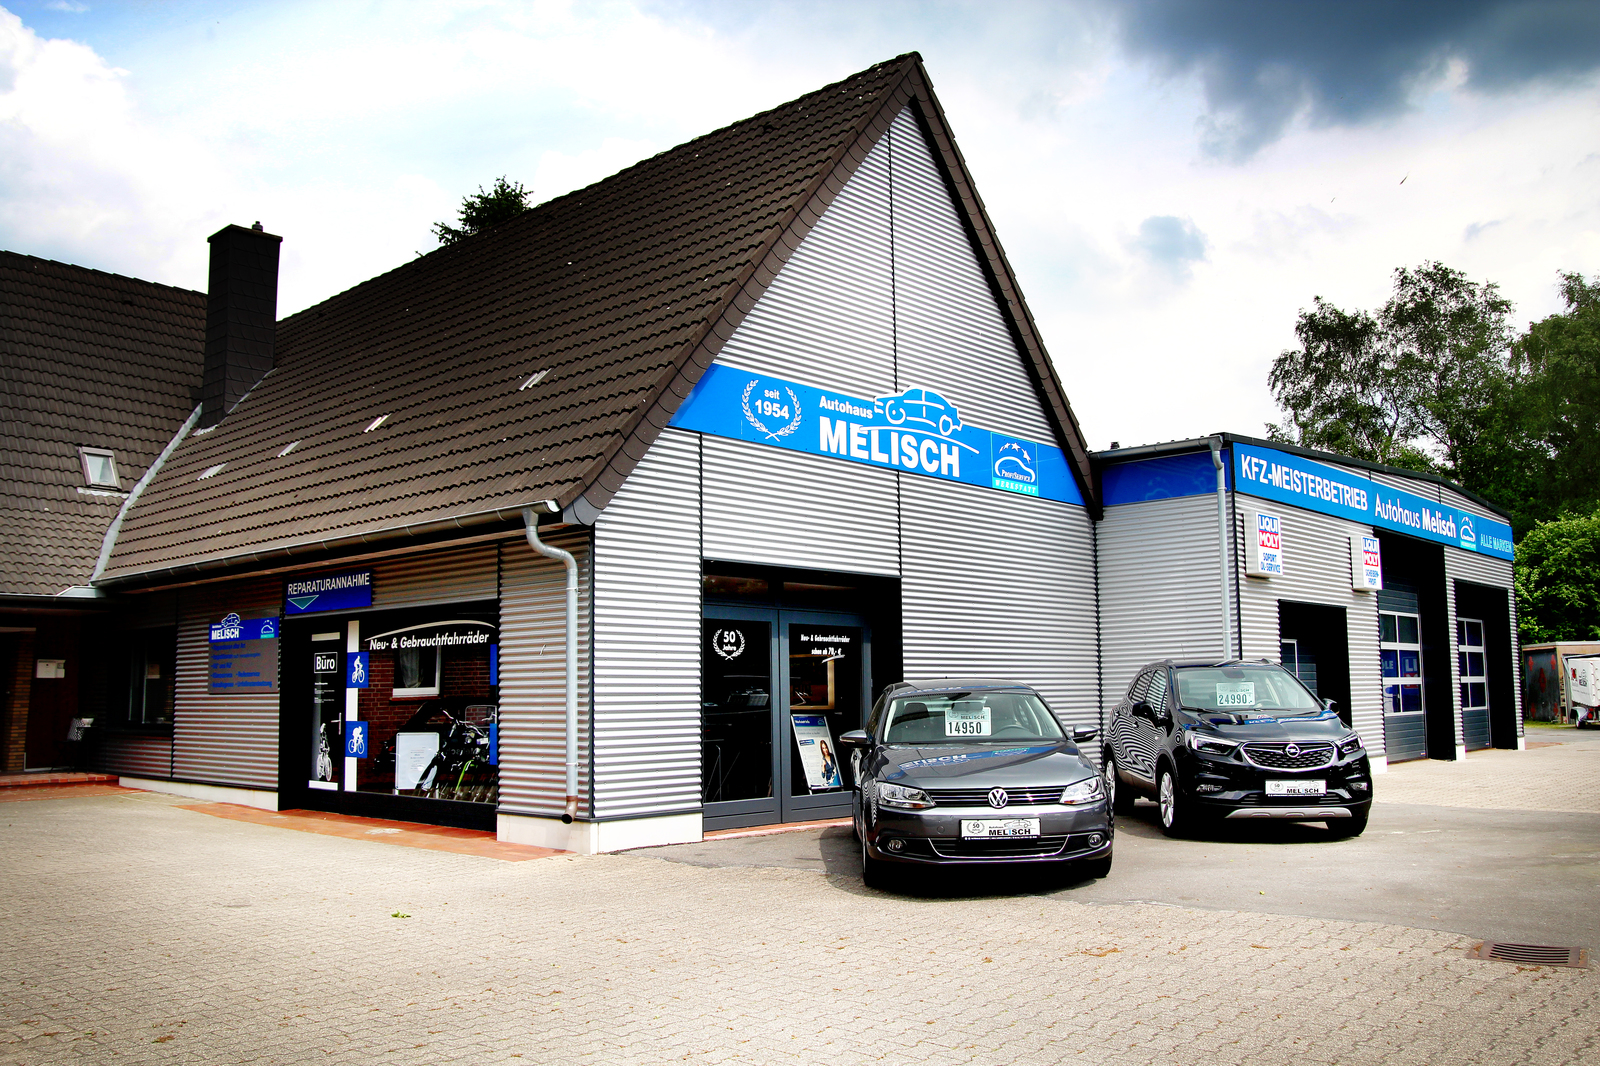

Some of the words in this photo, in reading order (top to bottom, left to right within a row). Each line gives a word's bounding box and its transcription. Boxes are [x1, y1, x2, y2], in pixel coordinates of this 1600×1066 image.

[764, 389, 780, 400] seit
[755, 399, 789, 419] 1954
[819, 396, 873, 419] Autohaus
[819, 416, 960, 477] MELISCH
[995, 479, 1036, 494] WERKSTATT
[1241, 454, 1368, 511] KFZ-MEISTERBETRIEB
[1375, 493, 1420, 529] Autohaus
[1422, 507, 1456, 538] Melisch
[1258, 514, 1279, 534] LIQUI
[1259, 530, 1279, 549] MOLY
[1362, 537, 1378, 553] LIQUI
[1480, 533, 1492, 549] ALLE
[1493, 536, 1513, 553] MARKEN
[1263, 552, 1277, 563] SOFORT
[1363, 551, 1379, 567] MOLY
[288, 572, 370, 595] REPARATURANNAHME
[211, 628, 239, 640] MELISCH
[369, 639, 389, 650] Neu-
[391, 637, 398, 649] &
[400, 630, 489, 648] Gebrauchtfahrräder
[723, 631, 735, 643] 50
[316, 655, 335, 670] Büro
[1218, 694, 1247, 705] 24990
[948, 721, 982, 734] 14950
